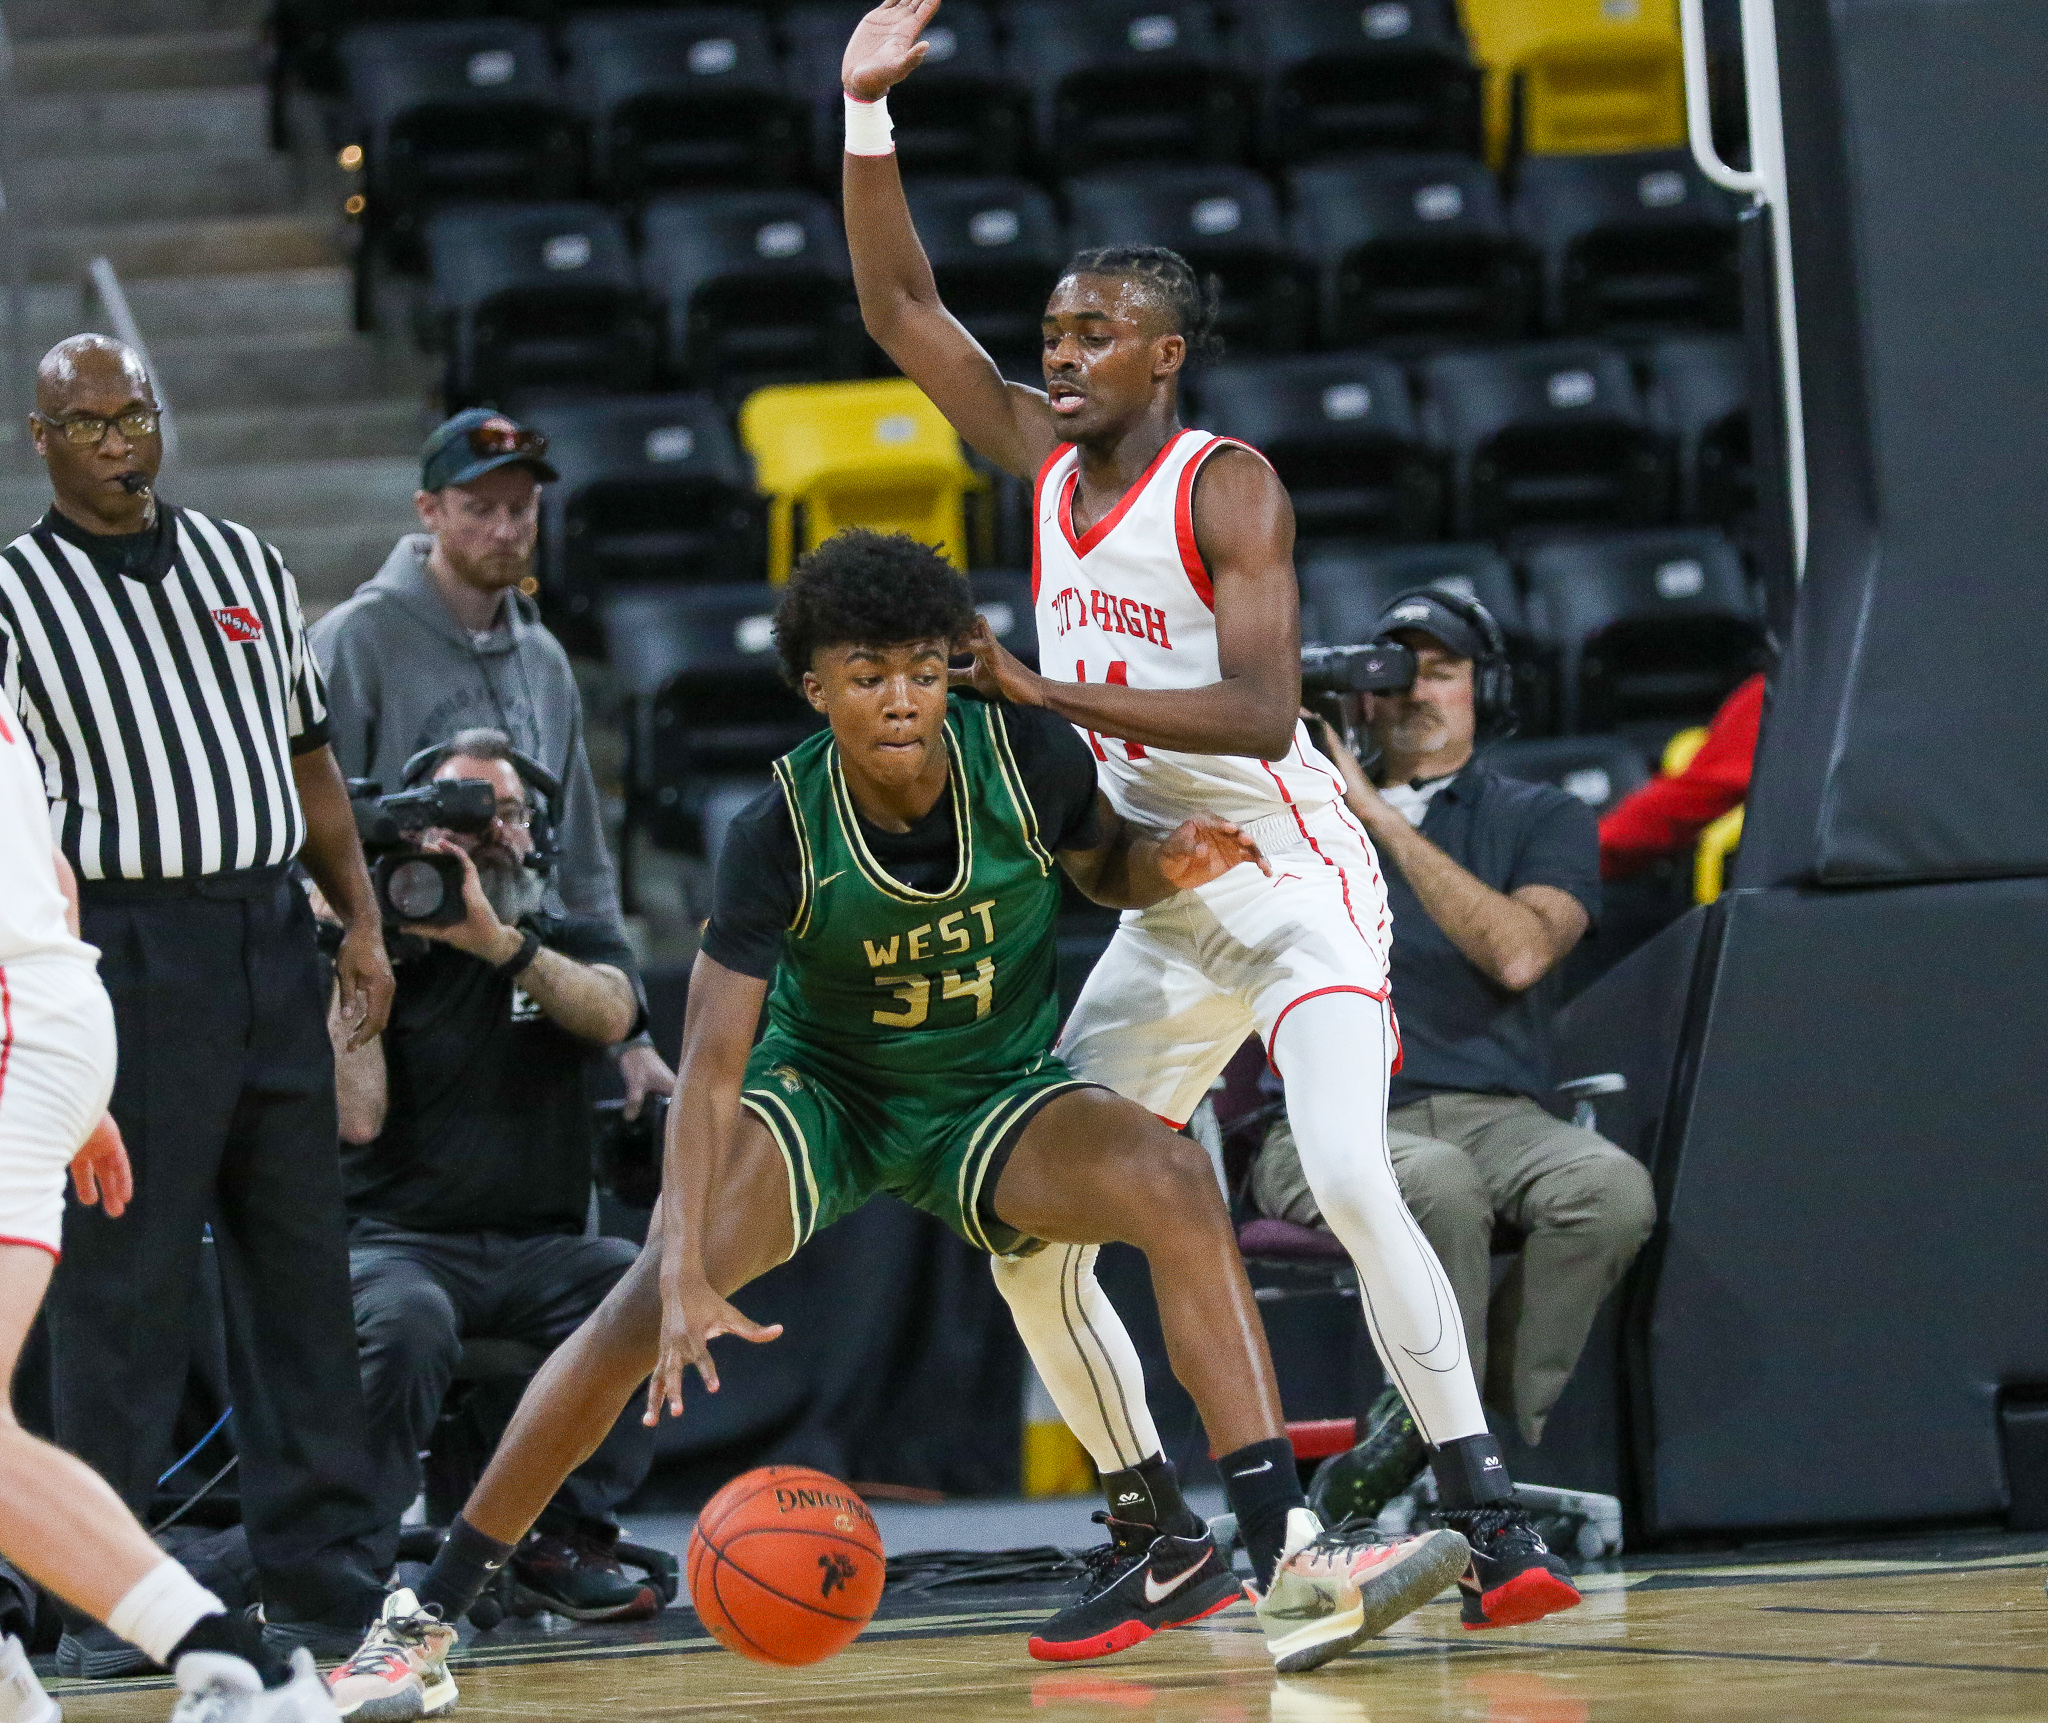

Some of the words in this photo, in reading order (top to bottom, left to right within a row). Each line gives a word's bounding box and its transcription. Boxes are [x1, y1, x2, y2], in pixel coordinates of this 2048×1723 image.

[216, 610, 261, 639] IHSAA
[1051, 587, 1088, 642] ITY
[1091, 589, 1173, 650] HIGH
[863, 900, 996, 967] WEST
[872, 956, 996, 1028] 34
